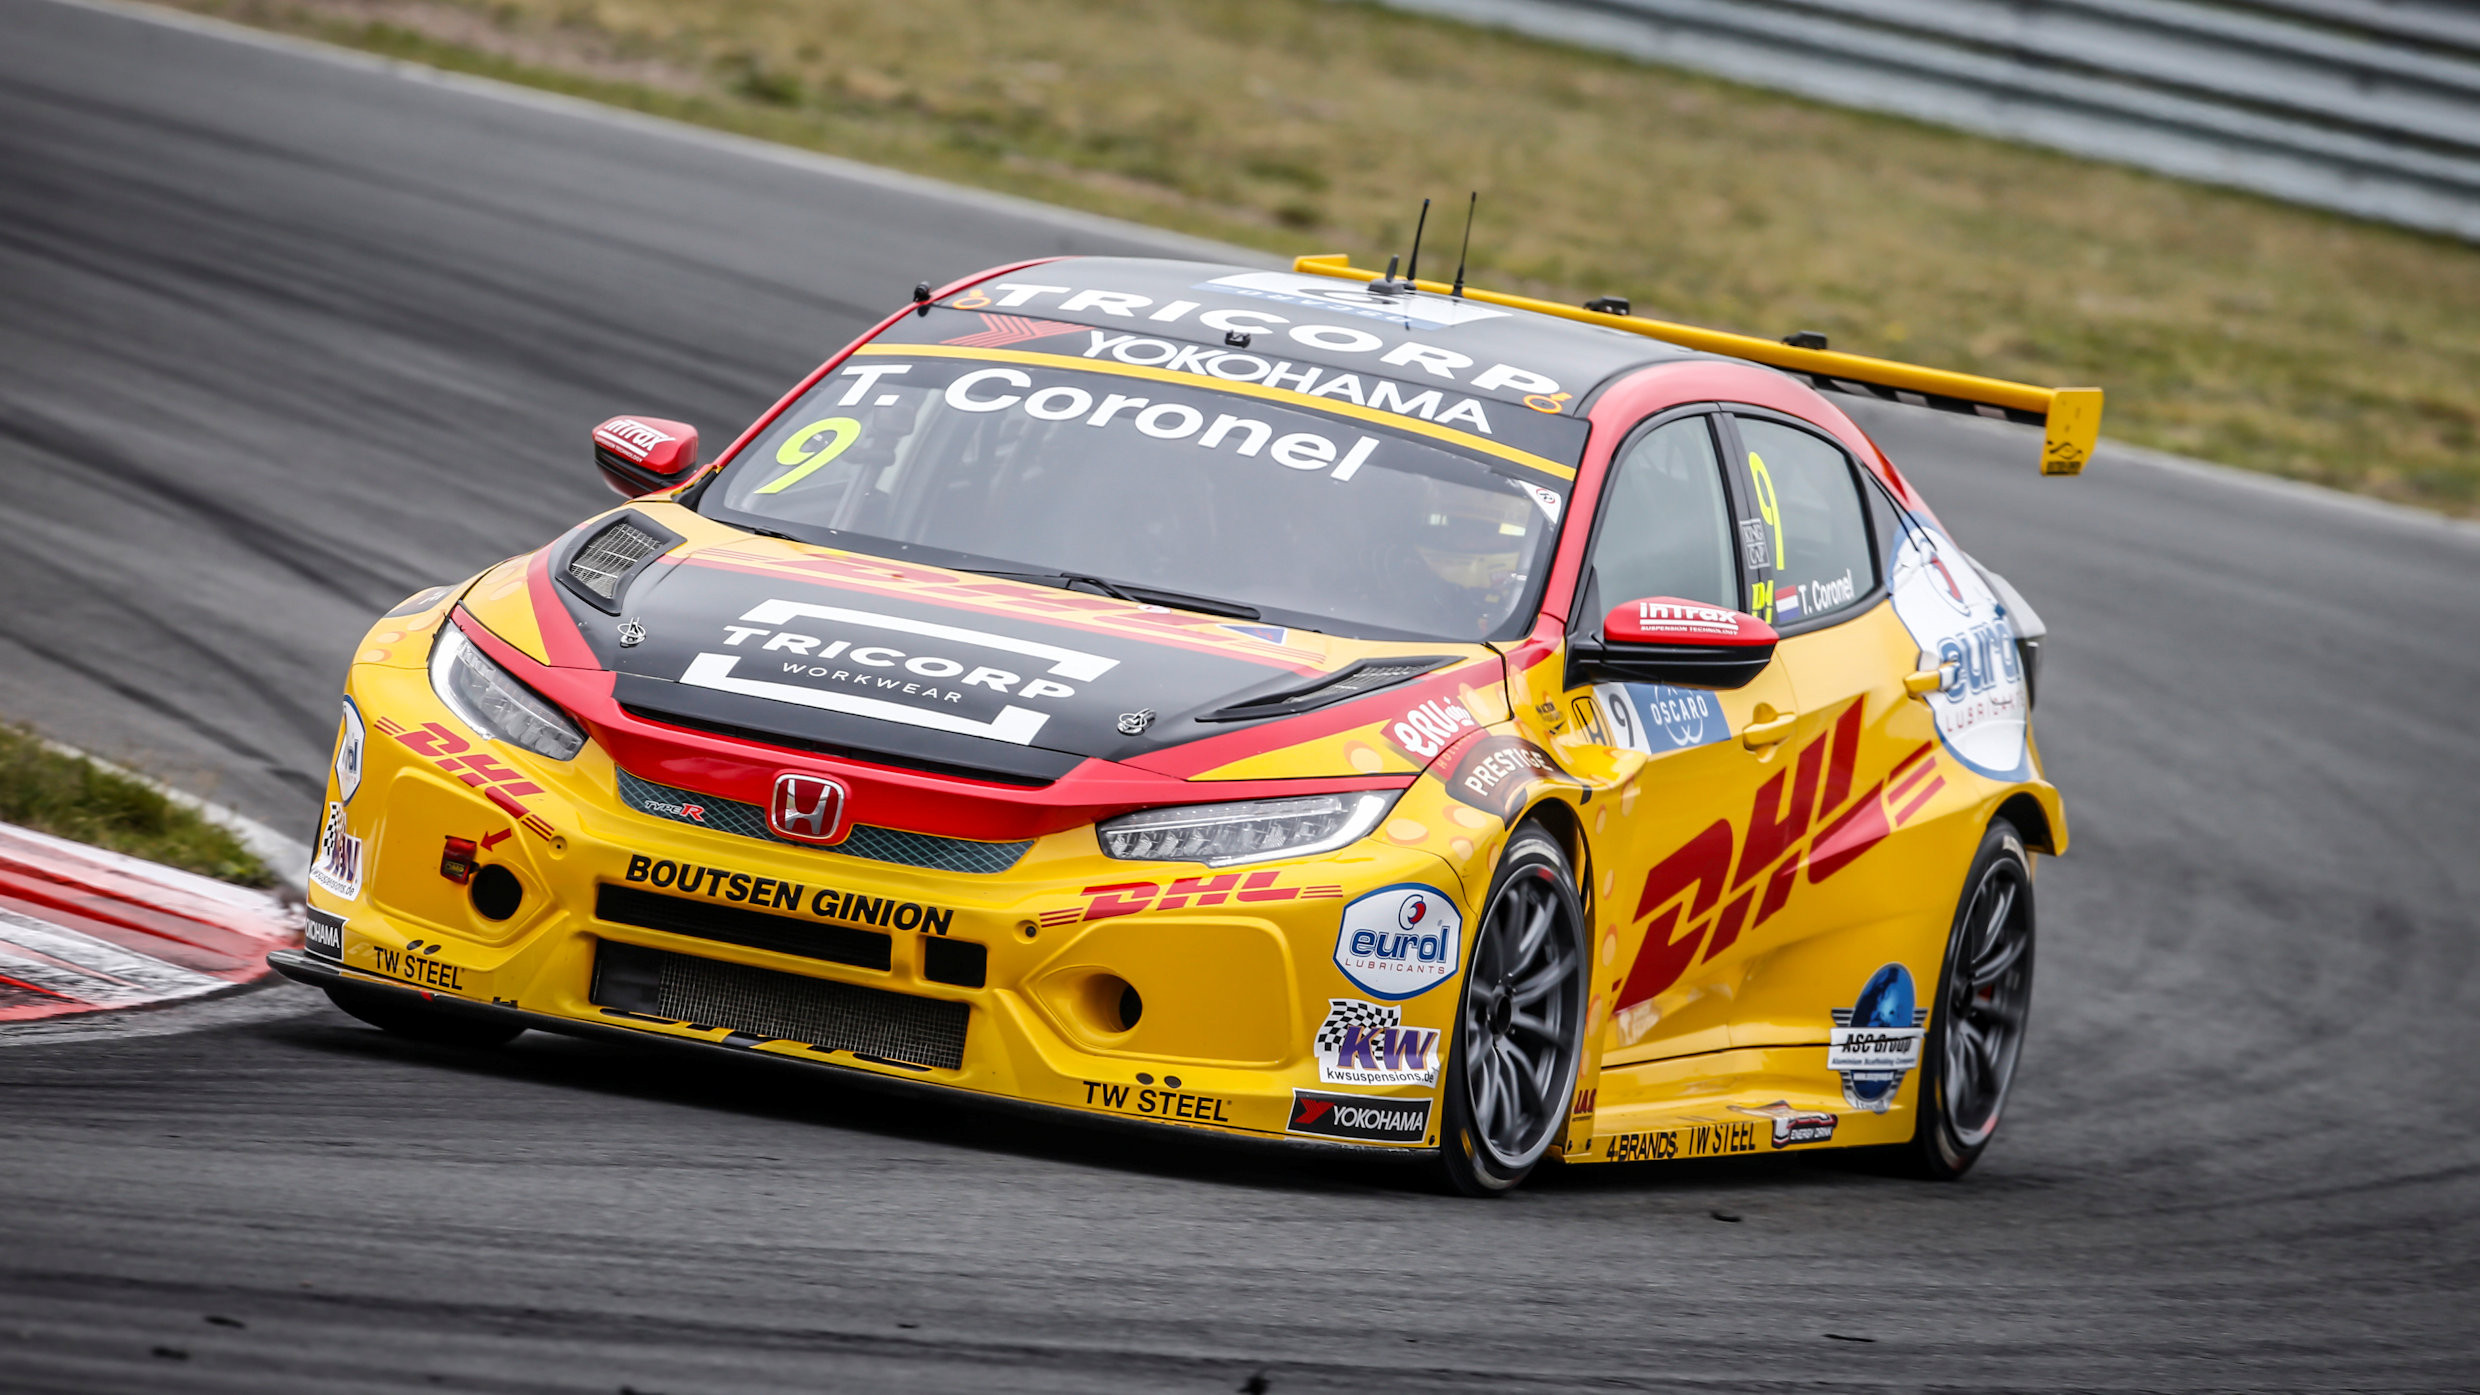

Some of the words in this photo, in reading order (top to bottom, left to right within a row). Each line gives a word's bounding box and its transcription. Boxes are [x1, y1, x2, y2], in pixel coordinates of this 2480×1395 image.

[995, 283, 1561, 397] TRICORP
[1081, 330, 1492, 434] YOKOHAMA
[837, 365, 912, 406] T.
[944, 368, 1379, 481] Coronel
[753, 417, 861, 493] 9
[1748, 452, 1784, 570] 9
[1798, 584, 1812, 615] T.
[1812, 568, 1855, 612] Coronel
[722, 625, 1075, 699] TRICORP
[782, 662, 962, 703] WORKWEAR
[1609, 694, 1634, 747] 9
[1650, 695, 1708, 725] OSCARO
[394, 722, 545, 820] DHL
[1465, 748, 1553, 796] PRESTIGE
[1612, 688, 1891, 1020] DHL
[625, 854, 804, 911] BOUTSEN
[811, 889, 954, 936] GINION
[1080, 871, 1300, 921] DHL
[374, 946, 400, 974] TW
[404, 955, 463, 990] STEEL
[1345, 958, 1446, 974] LUBRICANTS
[1350, 926, 1450, 964] eurol
[1337, 1025, 1438, 1071] KW
[1842, 1033, 1873, 1053] ASC
[1874, 1033, 1912, 1055] Group
[1326, 1067, 1434, 1084] kwsuspensions.de
[1082, 1081, 1130, 1109] TW
[1137, 1089, 1229, 1122] STEEL
[1333, 1105, 1424, 1131] YOKOHAMA
[1713, 1122, 1755, 1153] STEEL
